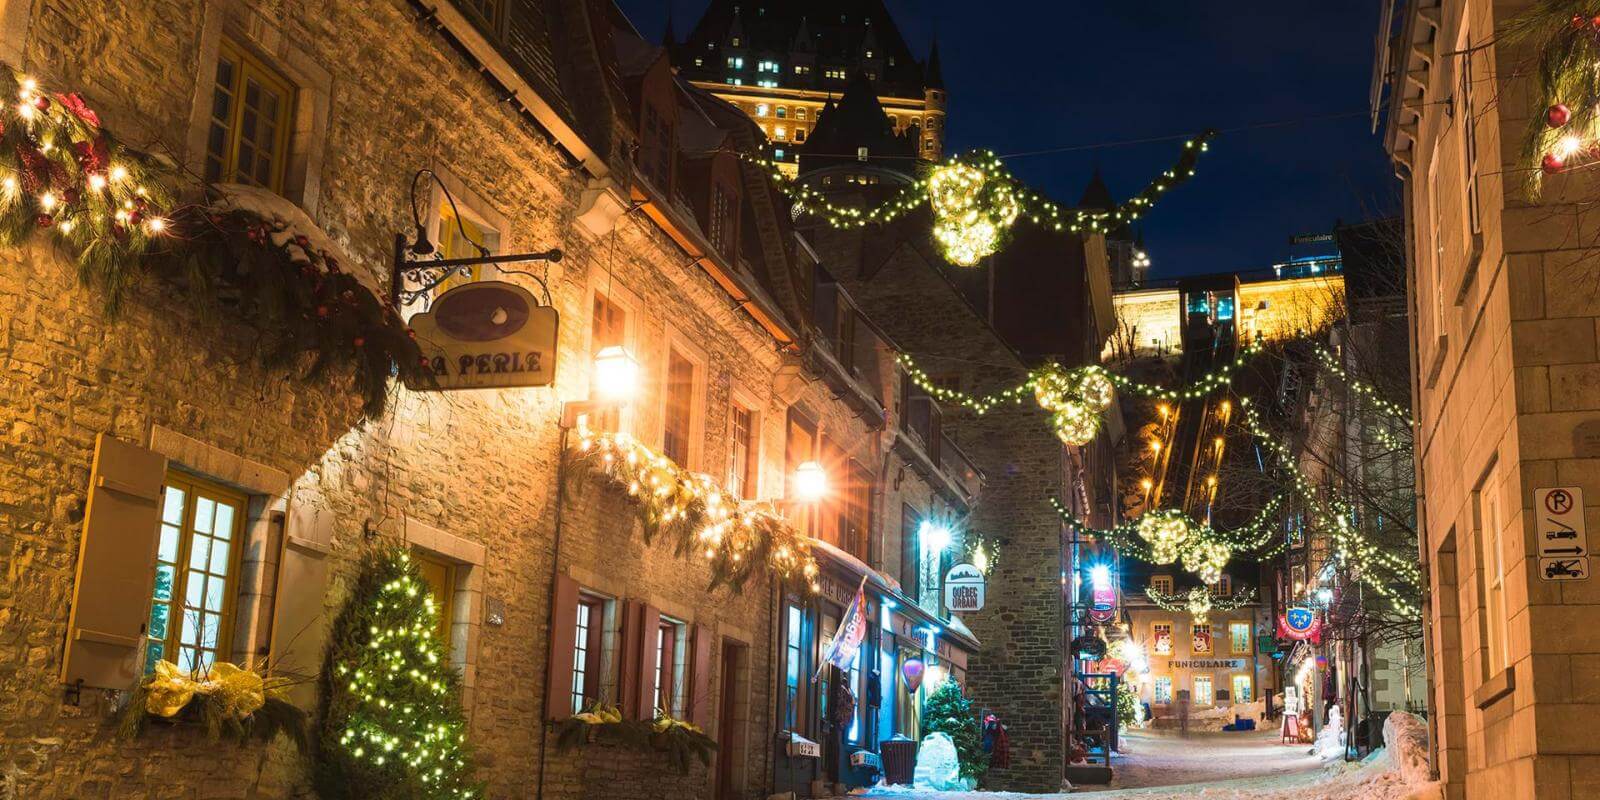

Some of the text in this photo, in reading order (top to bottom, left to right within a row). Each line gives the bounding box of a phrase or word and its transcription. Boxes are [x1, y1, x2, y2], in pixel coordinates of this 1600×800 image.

[459, 352, 542, 375] PERLE
[952, 585, 978, 598] QUÉBEC
[952, 597, 978, 609] URBAIN
[1168, 660, 1238, 669] FUNICULAIRE
